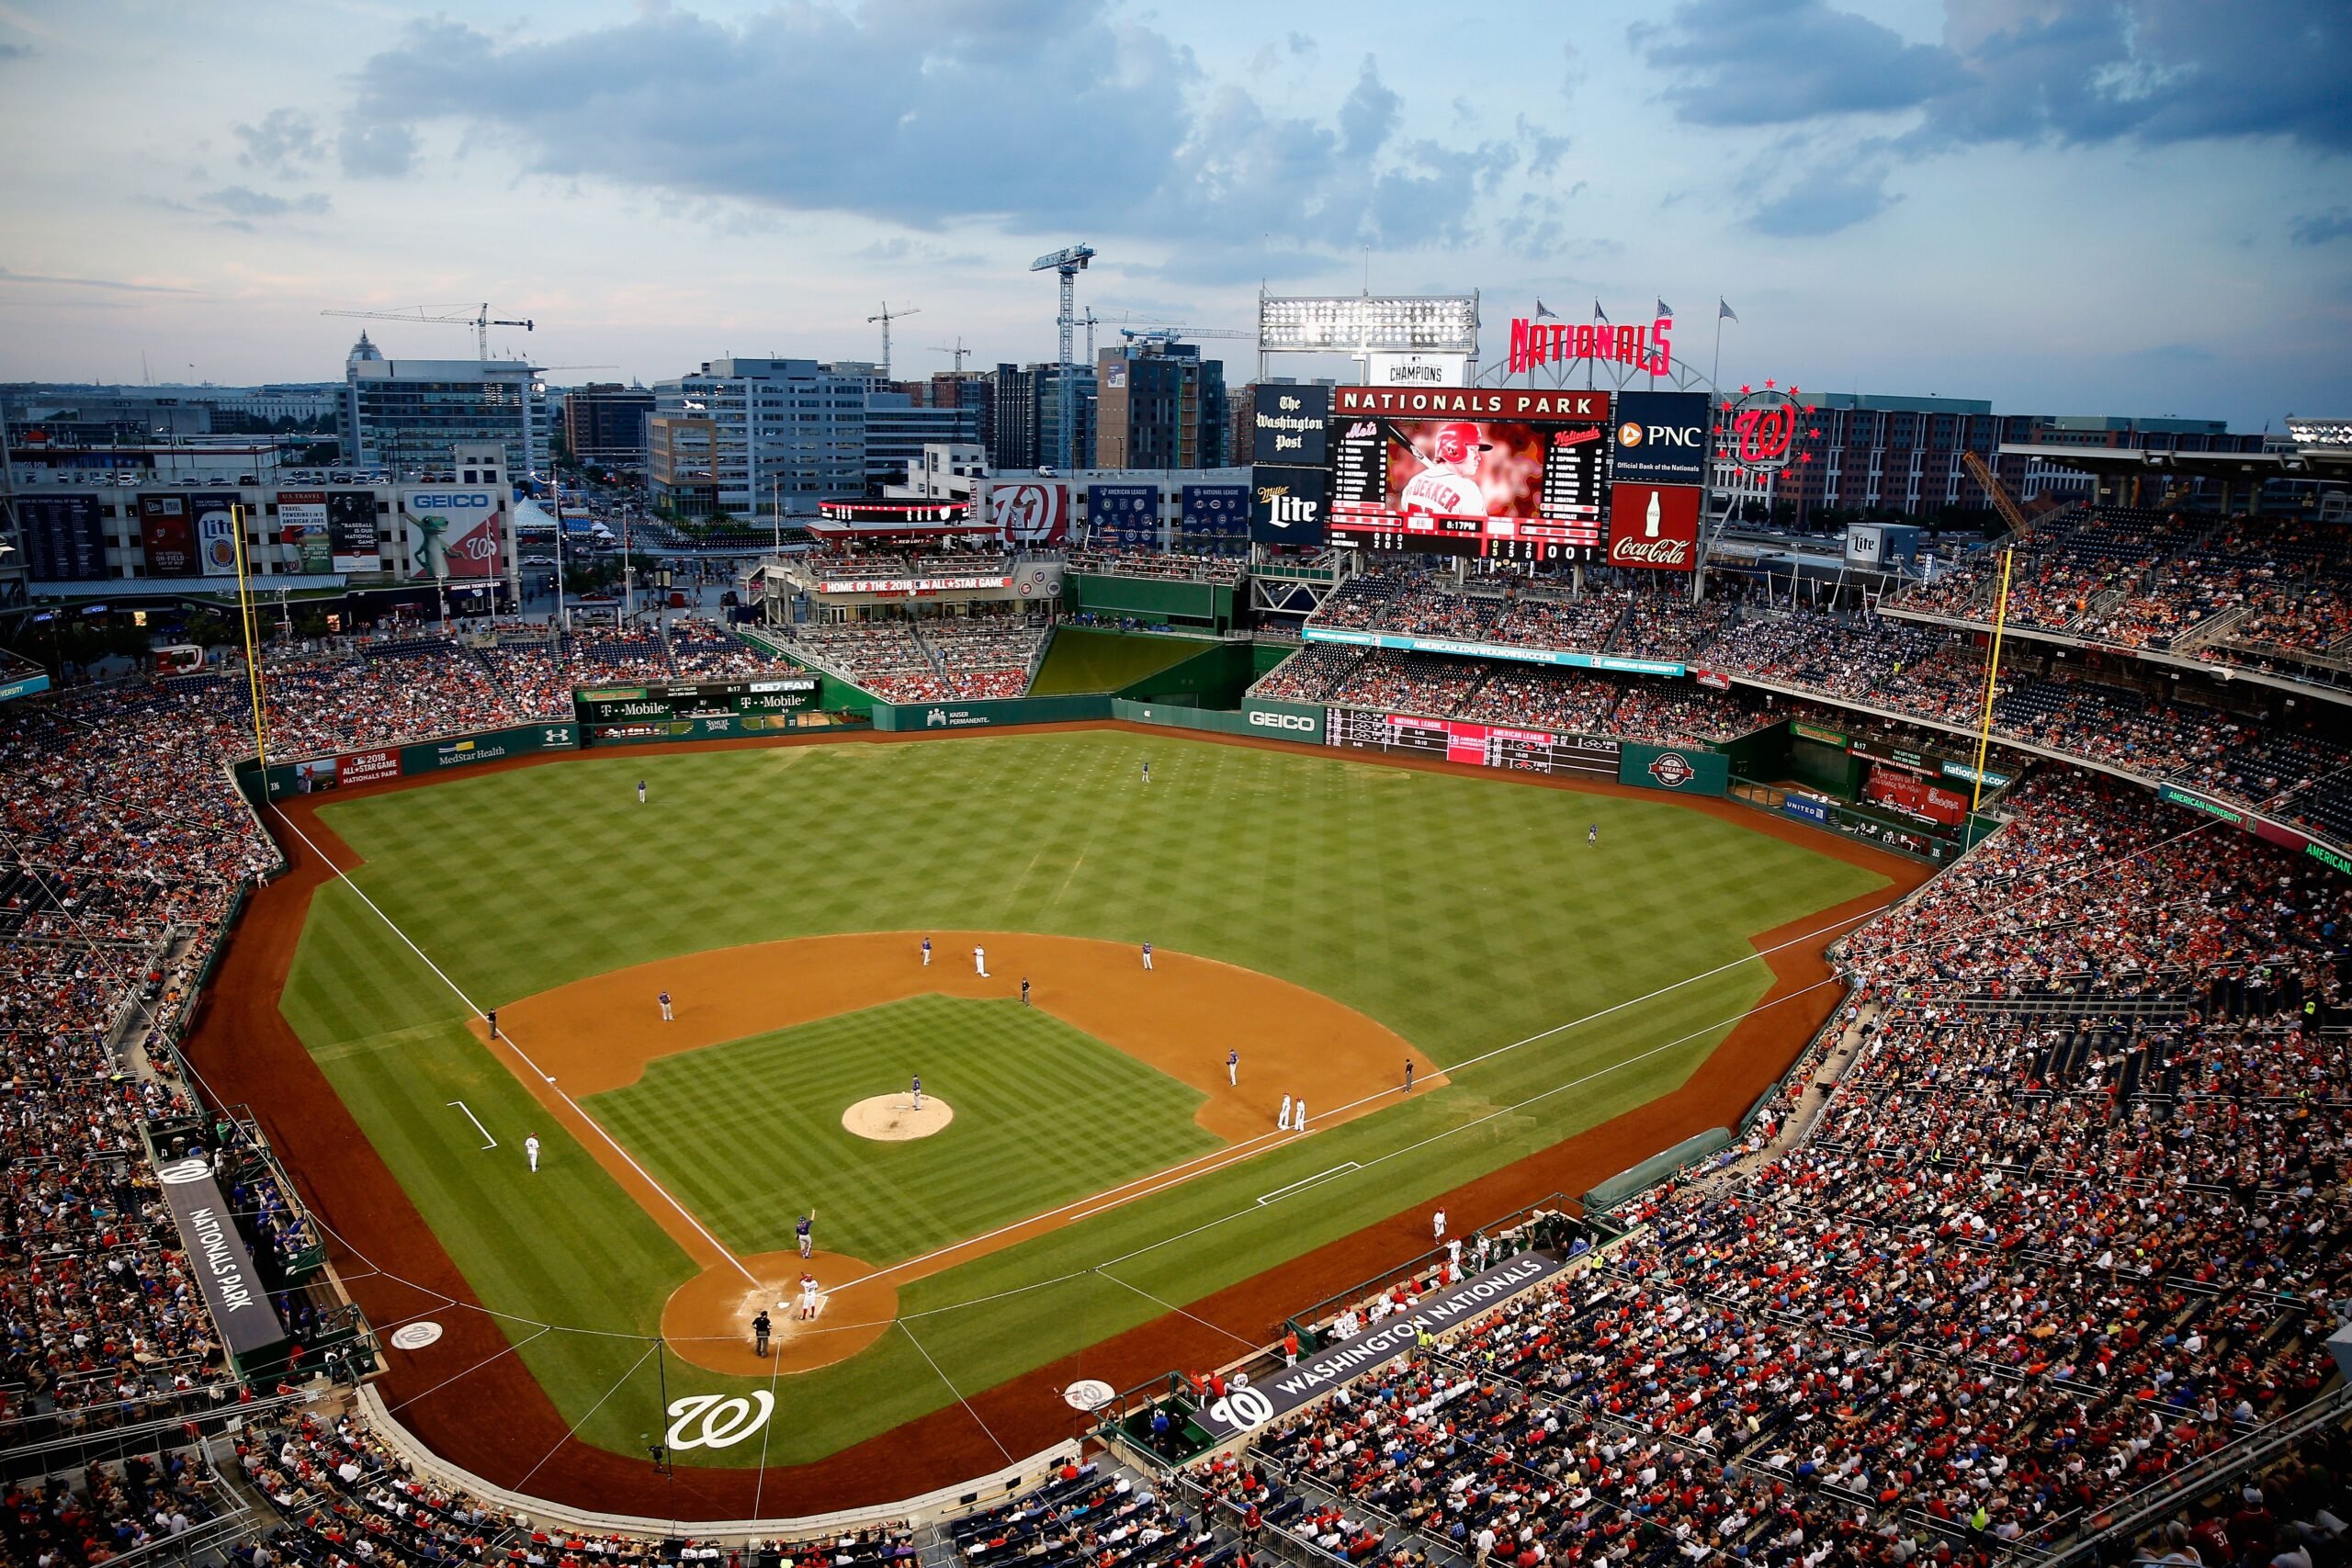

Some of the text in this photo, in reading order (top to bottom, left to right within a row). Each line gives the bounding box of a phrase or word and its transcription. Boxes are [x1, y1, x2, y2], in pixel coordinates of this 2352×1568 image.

[1509, 318, 1673, 377] NATIONALS
[1390, 366, 1442, 382] CHAMPIONS
[1279, 396, 1301, 412] The
[1344, 393, 1592, 413] NATIONALS PARK
[1256, 412, 1324, 433] Washington
[1345, 422, 1377, 438] Mets
[1275, 434, 1302, 451] Post
[1554, 425, 1600, 446] Nationals
[1647, 425, 1702, 447] PNC
[1617, 461, 1638, 469] Official
[1638, 462, 1654, 470] Bank
[1671, 464, 1700, 472] Nationals
[413, 494, 489, 508] GEICO
[1257, 486, 1290, 503] Miller
[1268, 495, 1317, 528] Lite
[203, 520, 235, 538] Lite
[1446, 521, 1476, 531] 8:17PM
[1612, 536, 1691, 565] Coca-Cola
[1853, 536, 1875, 553] Lite
[1492, 548, 1498, 557] 5
[1509, 549, 1514, 558] 5
[1548, 546, 1591, 560] 0 0 1
[827, 581, 854, 592] HOME
[856, 581, 868, 592] OF
[870, 581, 888, 591] THE
[889, 581, 912, 591] 2018
[978, 578, 1004, 588] GAME
[1603, 660, 1679, 673] AMERICAN UNIVERSITY
[1250, 710, 1316, 732] GEICO
[1395, 717, 1419, 726] NATIONAL
[1420, 720, 1442, 728] LEAGUE
[1493, 729, 1522, 739] AMERICAN
[1522, 732, 1545, 741] LEAGUE
[1853, 741, 1866, 750] 8:17
[367, 753, 386, 762] 2018
[439, 746, 505, 765] MedStar Health
[378, 760, 398, 770] GAME
[343, 770, 398, 784] NATIONALS PARK
[1786, 801, 1815, 815] UNITED
[2168, 791, 2243, 824] AMERICAN UNIVERSITY
[188, 1207, 254, 1314] NATIONALS PARK
[1275, 1258, 1543, 1396] WASHINGTON NATIONALS
